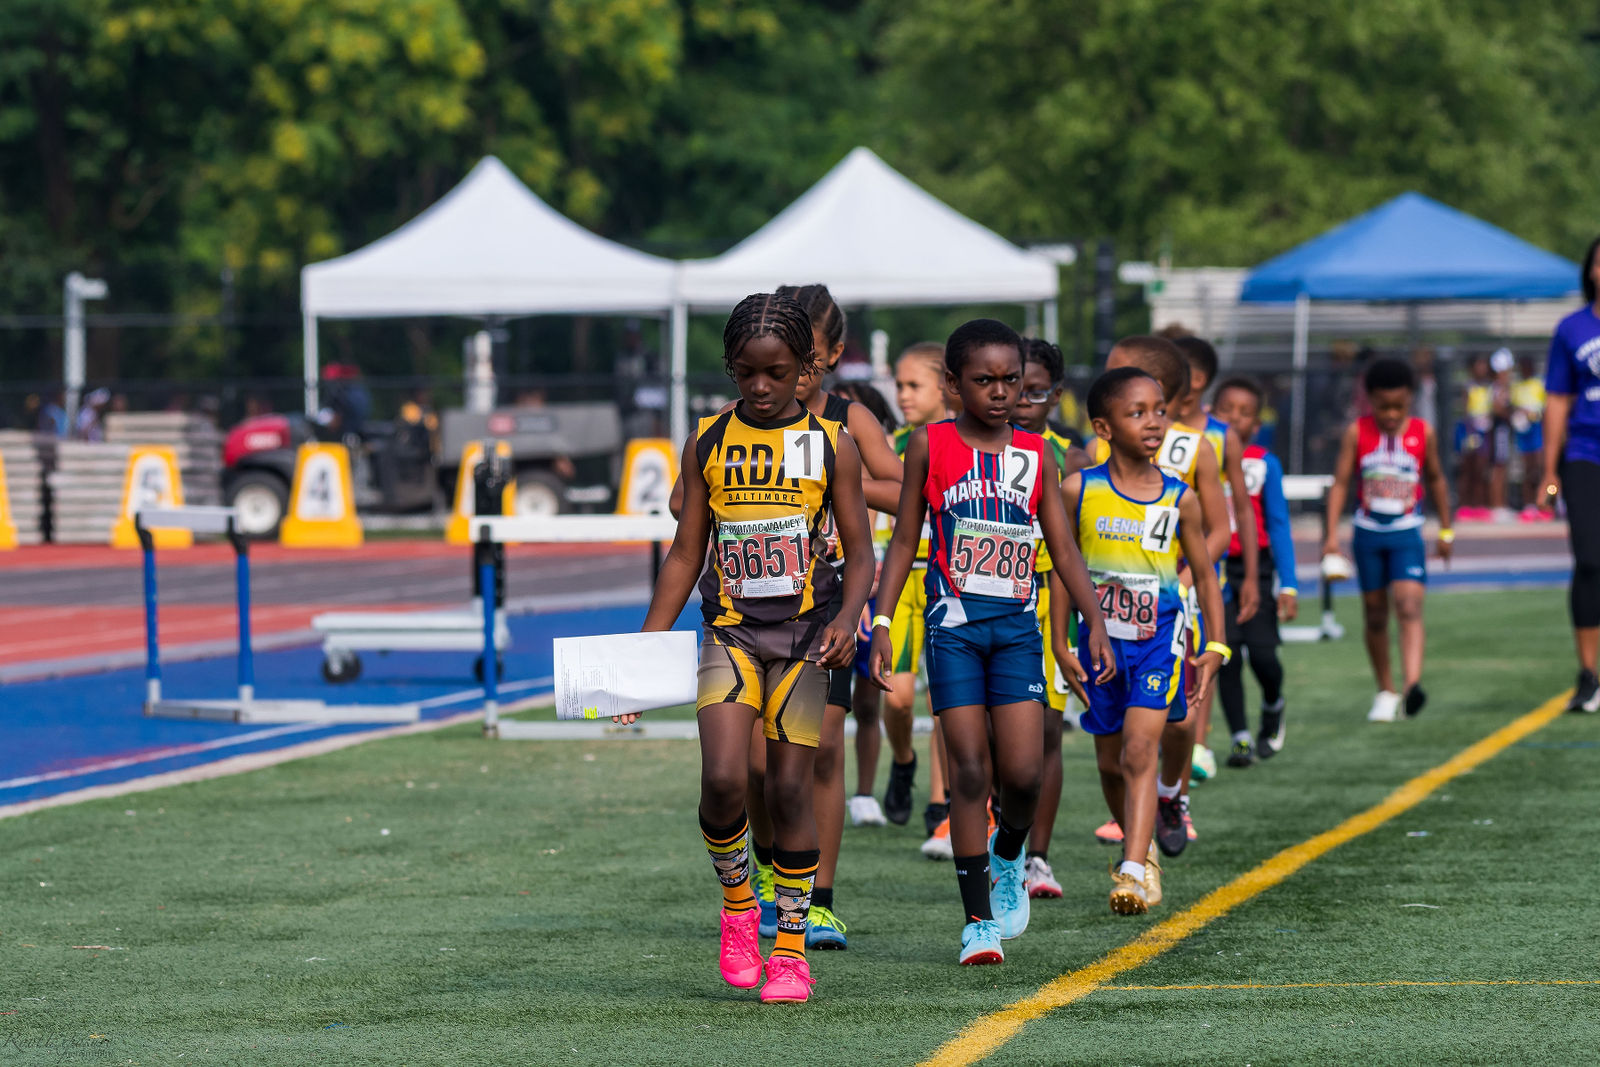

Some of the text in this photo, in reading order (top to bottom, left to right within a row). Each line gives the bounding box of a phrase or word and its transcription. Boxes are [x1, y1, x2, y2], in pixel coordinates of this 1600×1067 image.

[794, 433, 812, 477] 1
[1169, 436, 1191, 464] 6
[309, 468, 332, 501] 4
[639, 463, 664, 502] 2
[1010, 451, 1030, 493] 2
[728, 493, 796, 503] BALTIMORE
[766, 517, 801, 532] VALLEY
[1097, 533, 1136, 543] TRACK
[1150, 510, 1171, 549] 4
[722, 533, 805, 580] 5651
[954, 534, 1032, 580] 5288
[1092, 581, 1154, 624] 498
